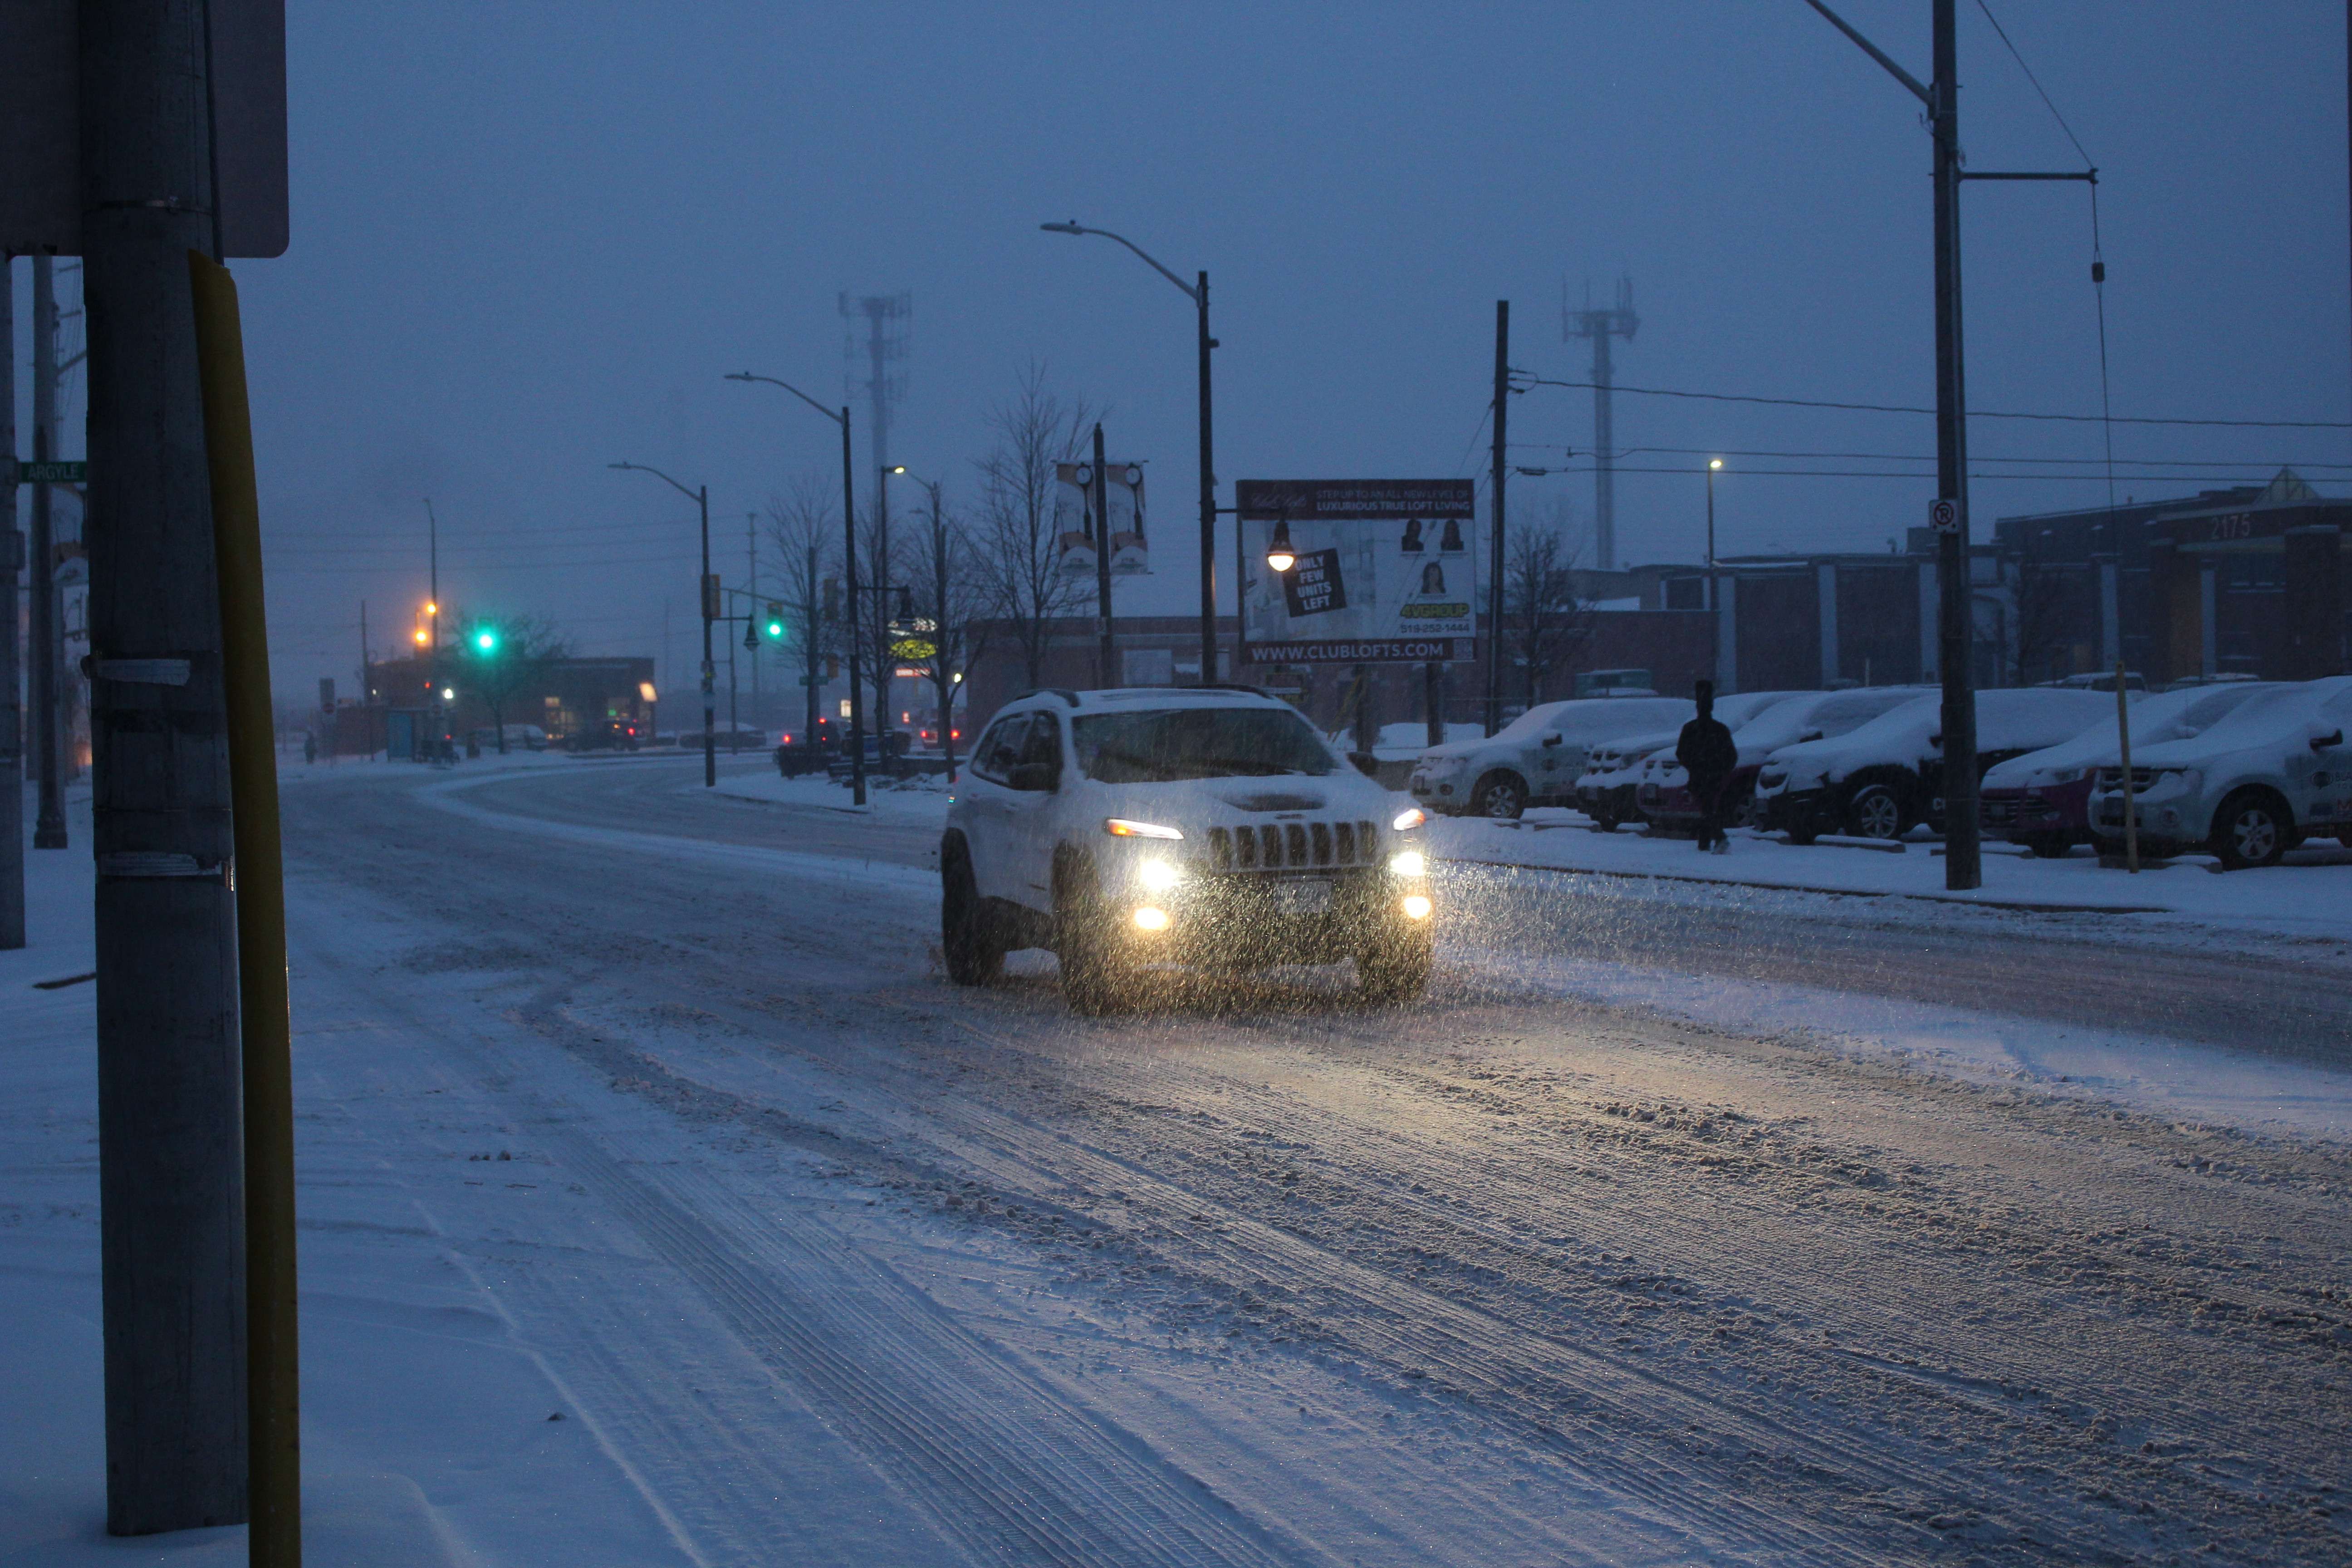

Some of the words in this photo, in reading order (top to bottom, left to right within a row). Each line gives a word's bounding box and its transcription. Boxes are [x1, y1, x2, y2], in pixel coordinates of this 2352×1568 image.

[28, 464, 78, 480] ARGYLE
[1317, 501, 1378, 511] LUXURIOUS
[1379, 501, 1406, 511] TRUE
[1408, 501, 1433, 511] LOFT
[1435, 501, 1470, 511] LIVING
[2211, 514, 2250, 539] 2175
[1296, 556, 1324, 570] ONLY
[1300, 569, 1324, 583] FEW
[1298, 581, 1332, 598] UNITS
[1303, 595, 1330, 610] LEFT
[1252, 643, 1443, 661] WWW.CLUBLOFTS.COM
